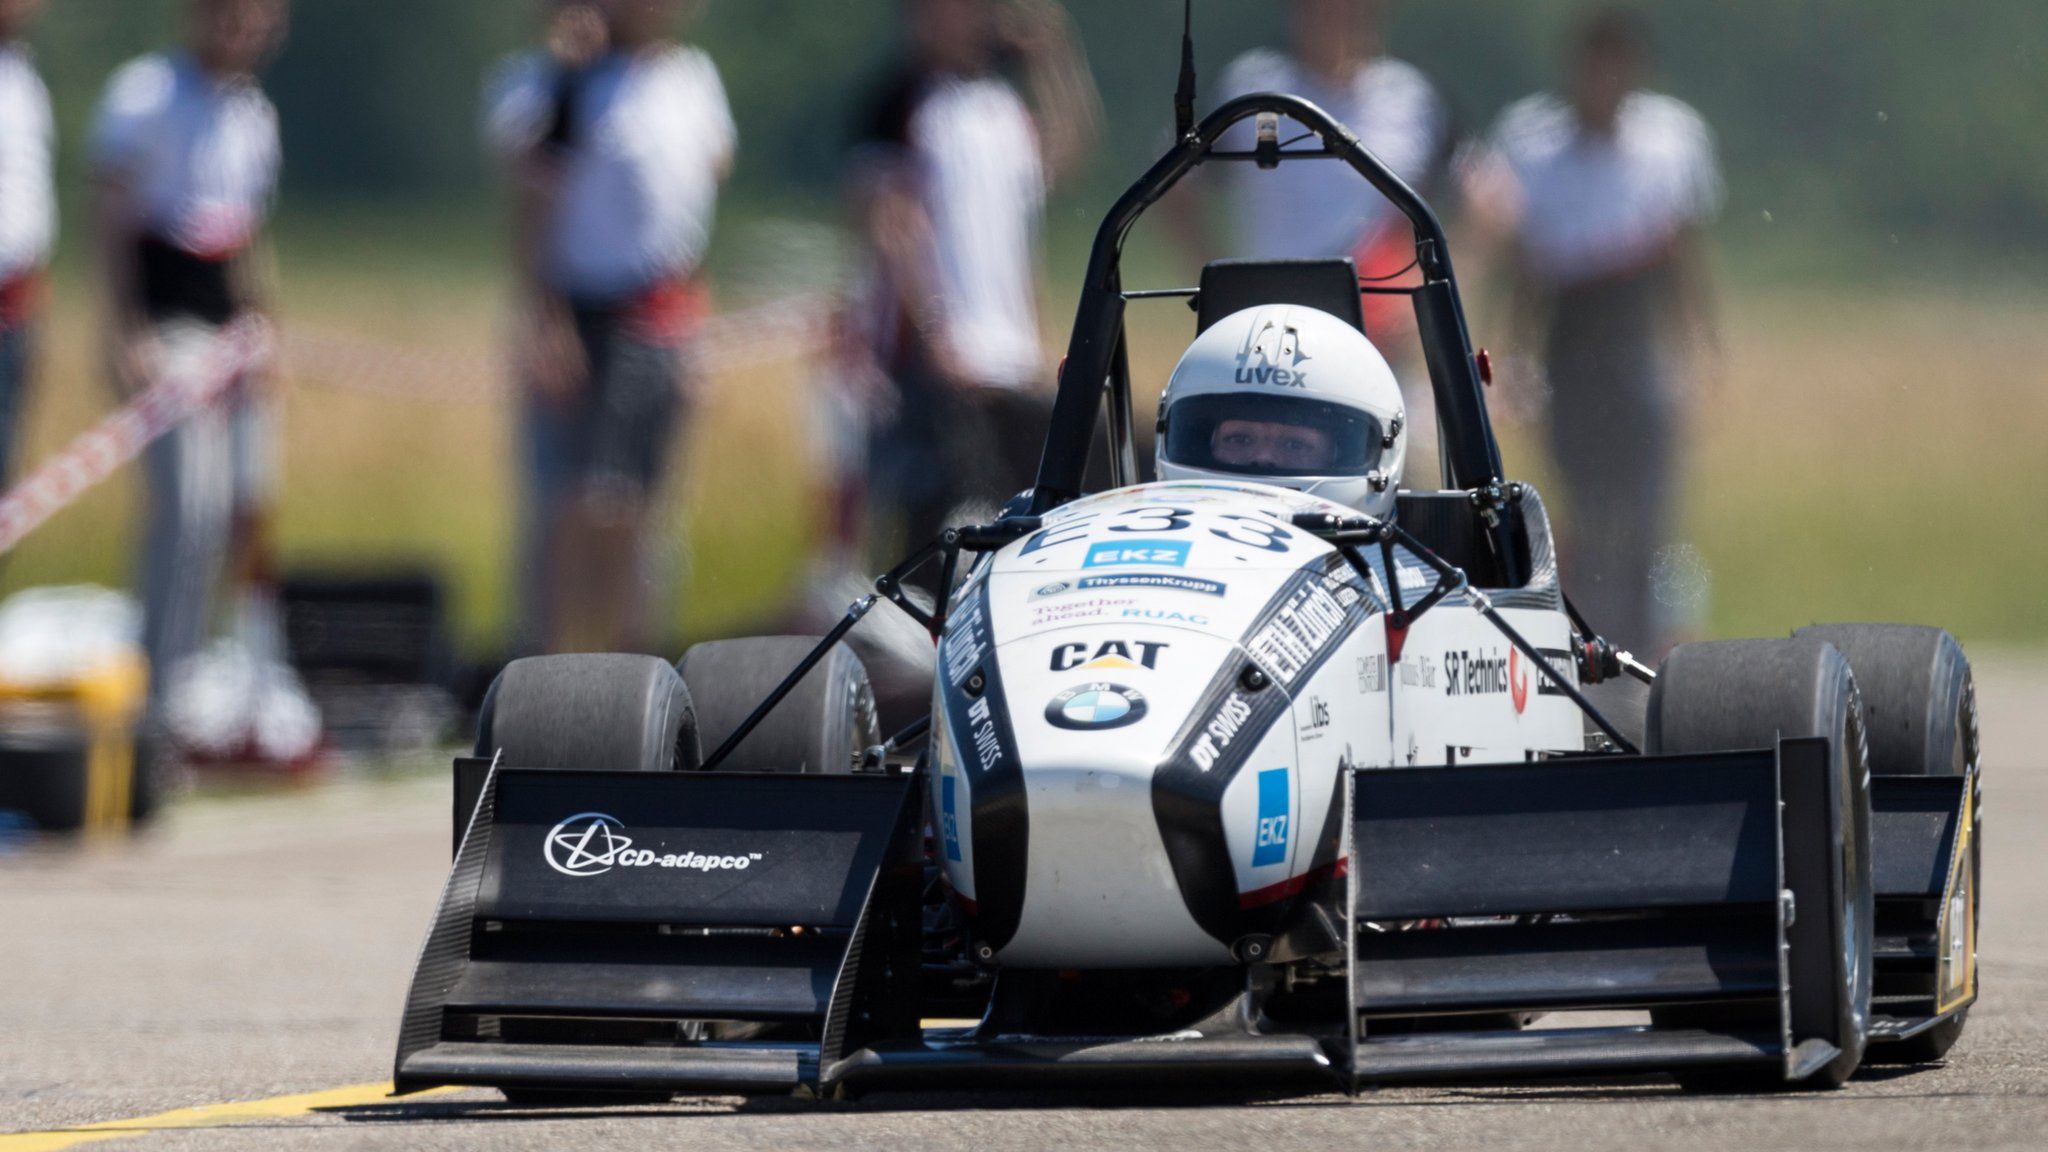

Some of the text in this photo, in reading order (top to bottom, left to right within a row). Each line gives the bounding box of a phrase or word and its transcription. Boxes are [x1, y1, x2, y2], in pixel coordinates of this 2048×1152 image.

[1235, 366, 1307, 388] uvex
[1092, 548, 1180, 565] EKZ
[1085, 576, 1218, 593] ThyssenKrupp
[1033, 598, 1138, 615] Together
[1120, 608, 1210, 626] RUAG
[1049, 639, 1171, 672] CAT
[1444, 650, 1461, 697] SR
[1461, 646, 1508, 696] Technics
[967, 695, 1003, 772] DT SWISS
[1189, 692, 1252, 773] DT SWISS
[1258, 814, 1288, 847] EKZ
